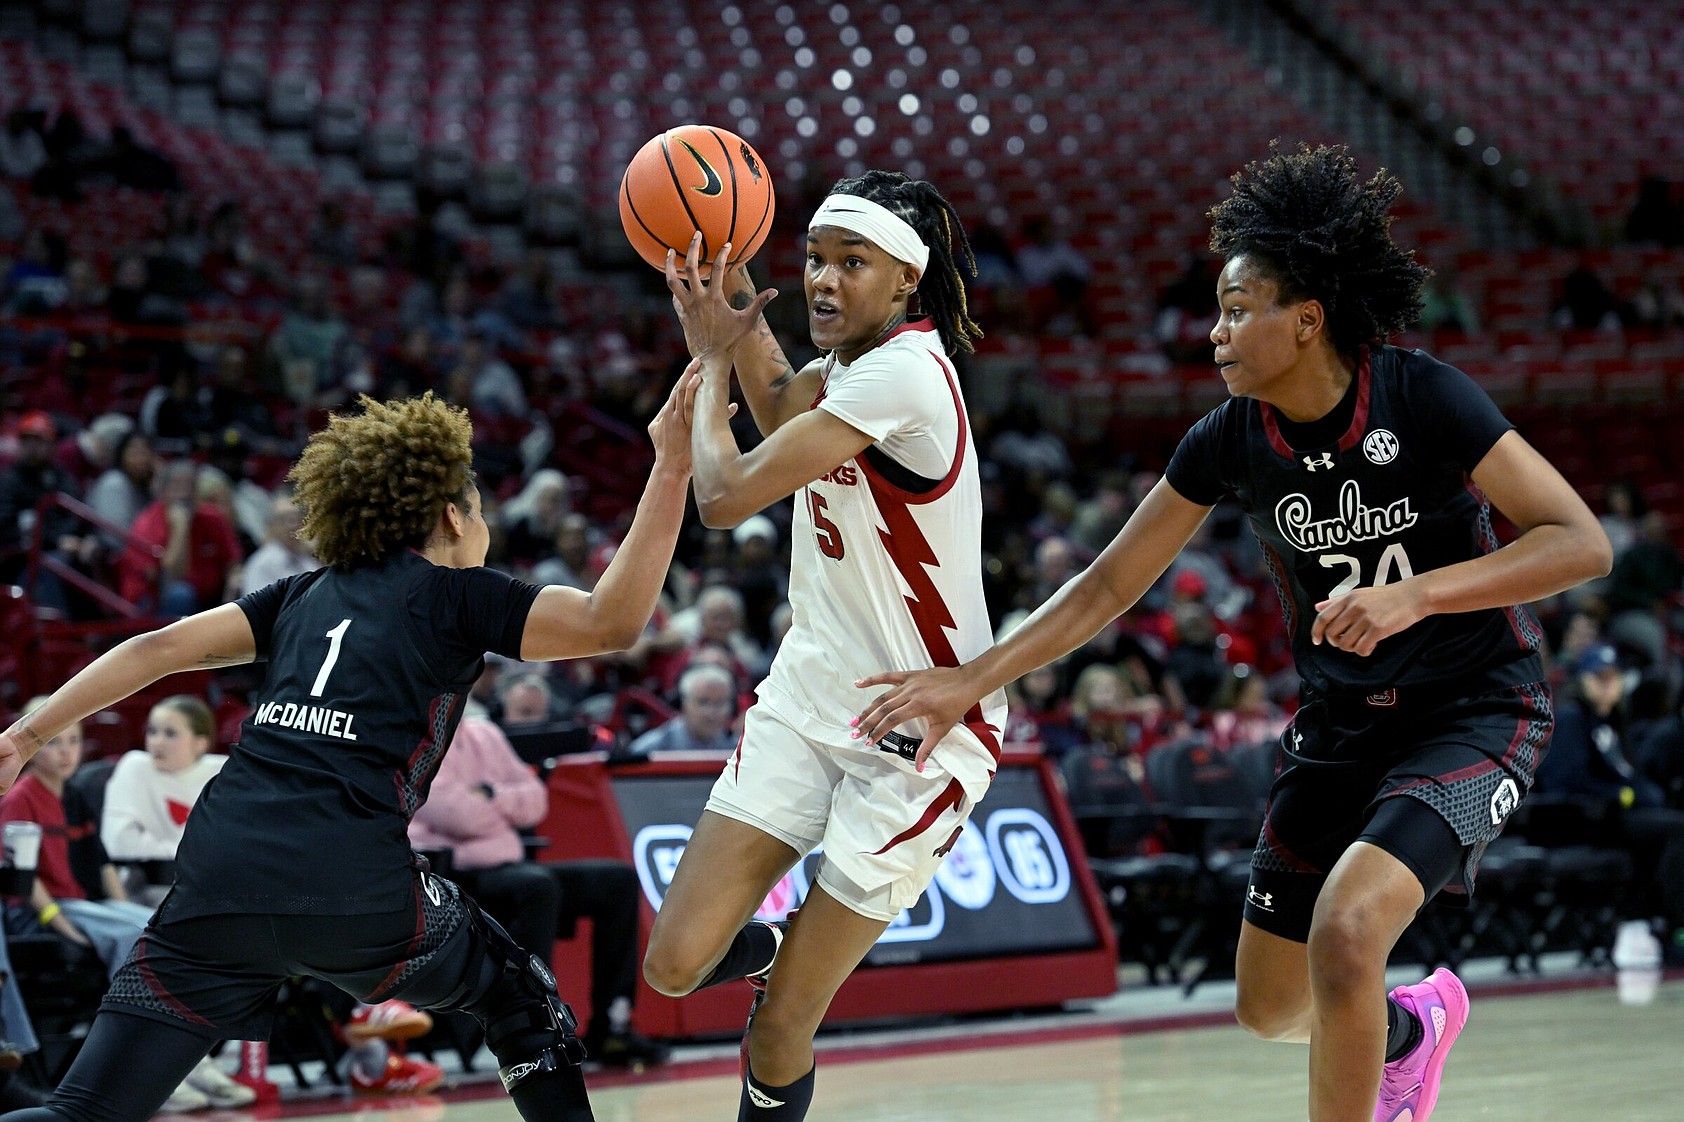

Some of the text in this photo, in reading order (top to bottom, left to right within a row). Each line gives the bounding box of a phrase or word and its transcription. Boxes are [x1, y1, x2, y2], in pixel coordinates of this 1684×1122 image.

[1366, 431, 1397, 462] SEC
[1275, 479, 1419, 552] Carolina
[309, 618, 352, 697] 1
[902, 743, 914, 754] 44
